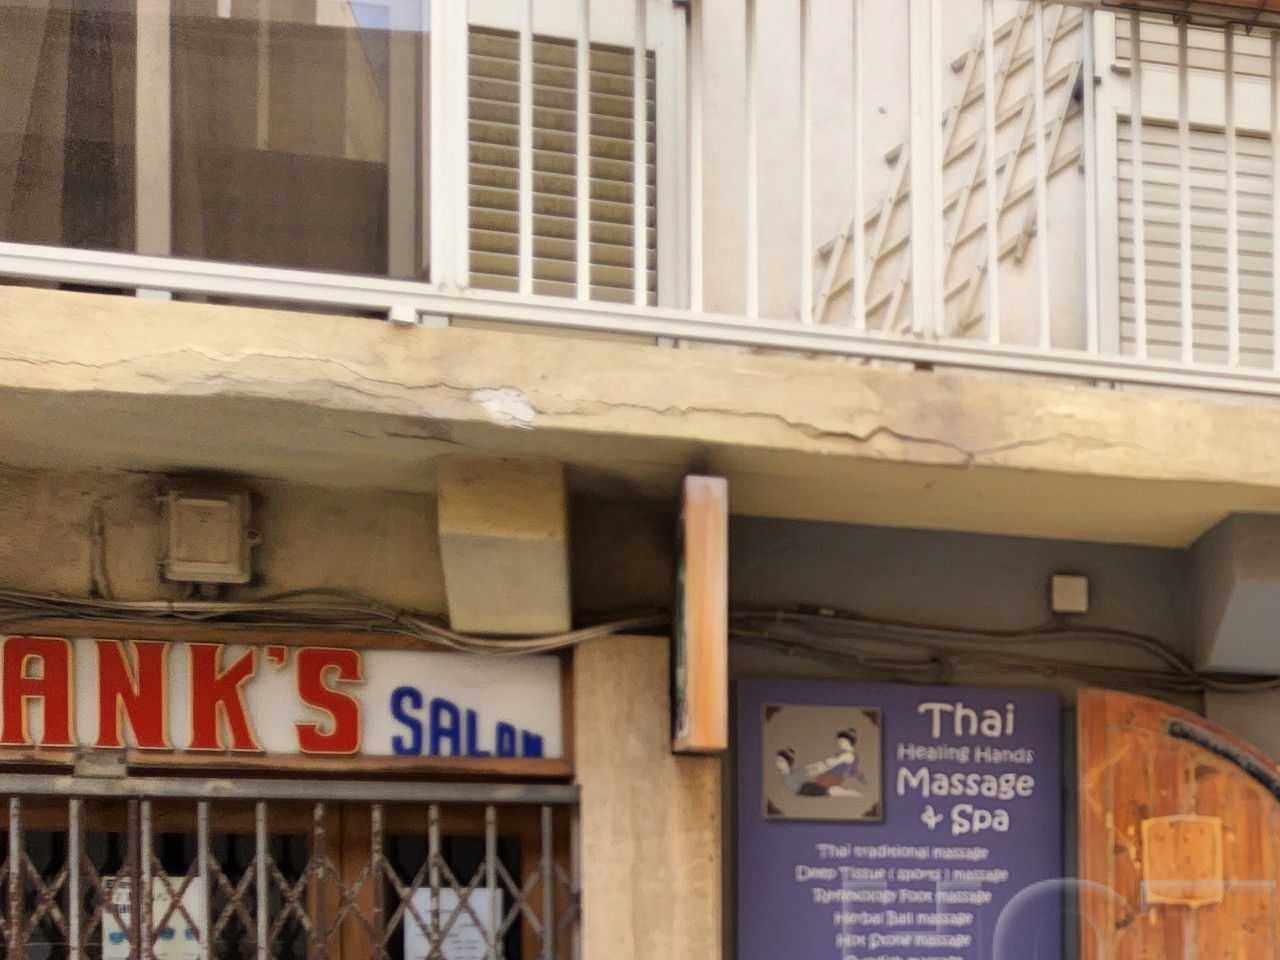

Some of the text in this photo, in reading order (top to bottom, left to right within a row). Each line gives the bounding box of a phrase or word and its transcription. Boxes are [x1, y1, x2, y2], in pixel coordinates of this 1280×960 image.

[917, 701, 1016, 739] Thai
[897, 743, 1034, 765] Healing Hands
[897, 767, 1035, 800] Massage
[951, 803, 1010, 836] Spa
[816, 843, 989, 862] Thai traditional massage
[795, 865, 837, 882] Deep
[839, 865, 886, 880] Tissue
[954, 868, 1009, 884] massage
[935, 888, 993, 905] massage
[916, 911, 974, 927] massage
[914, 933, 972, 948] massage
